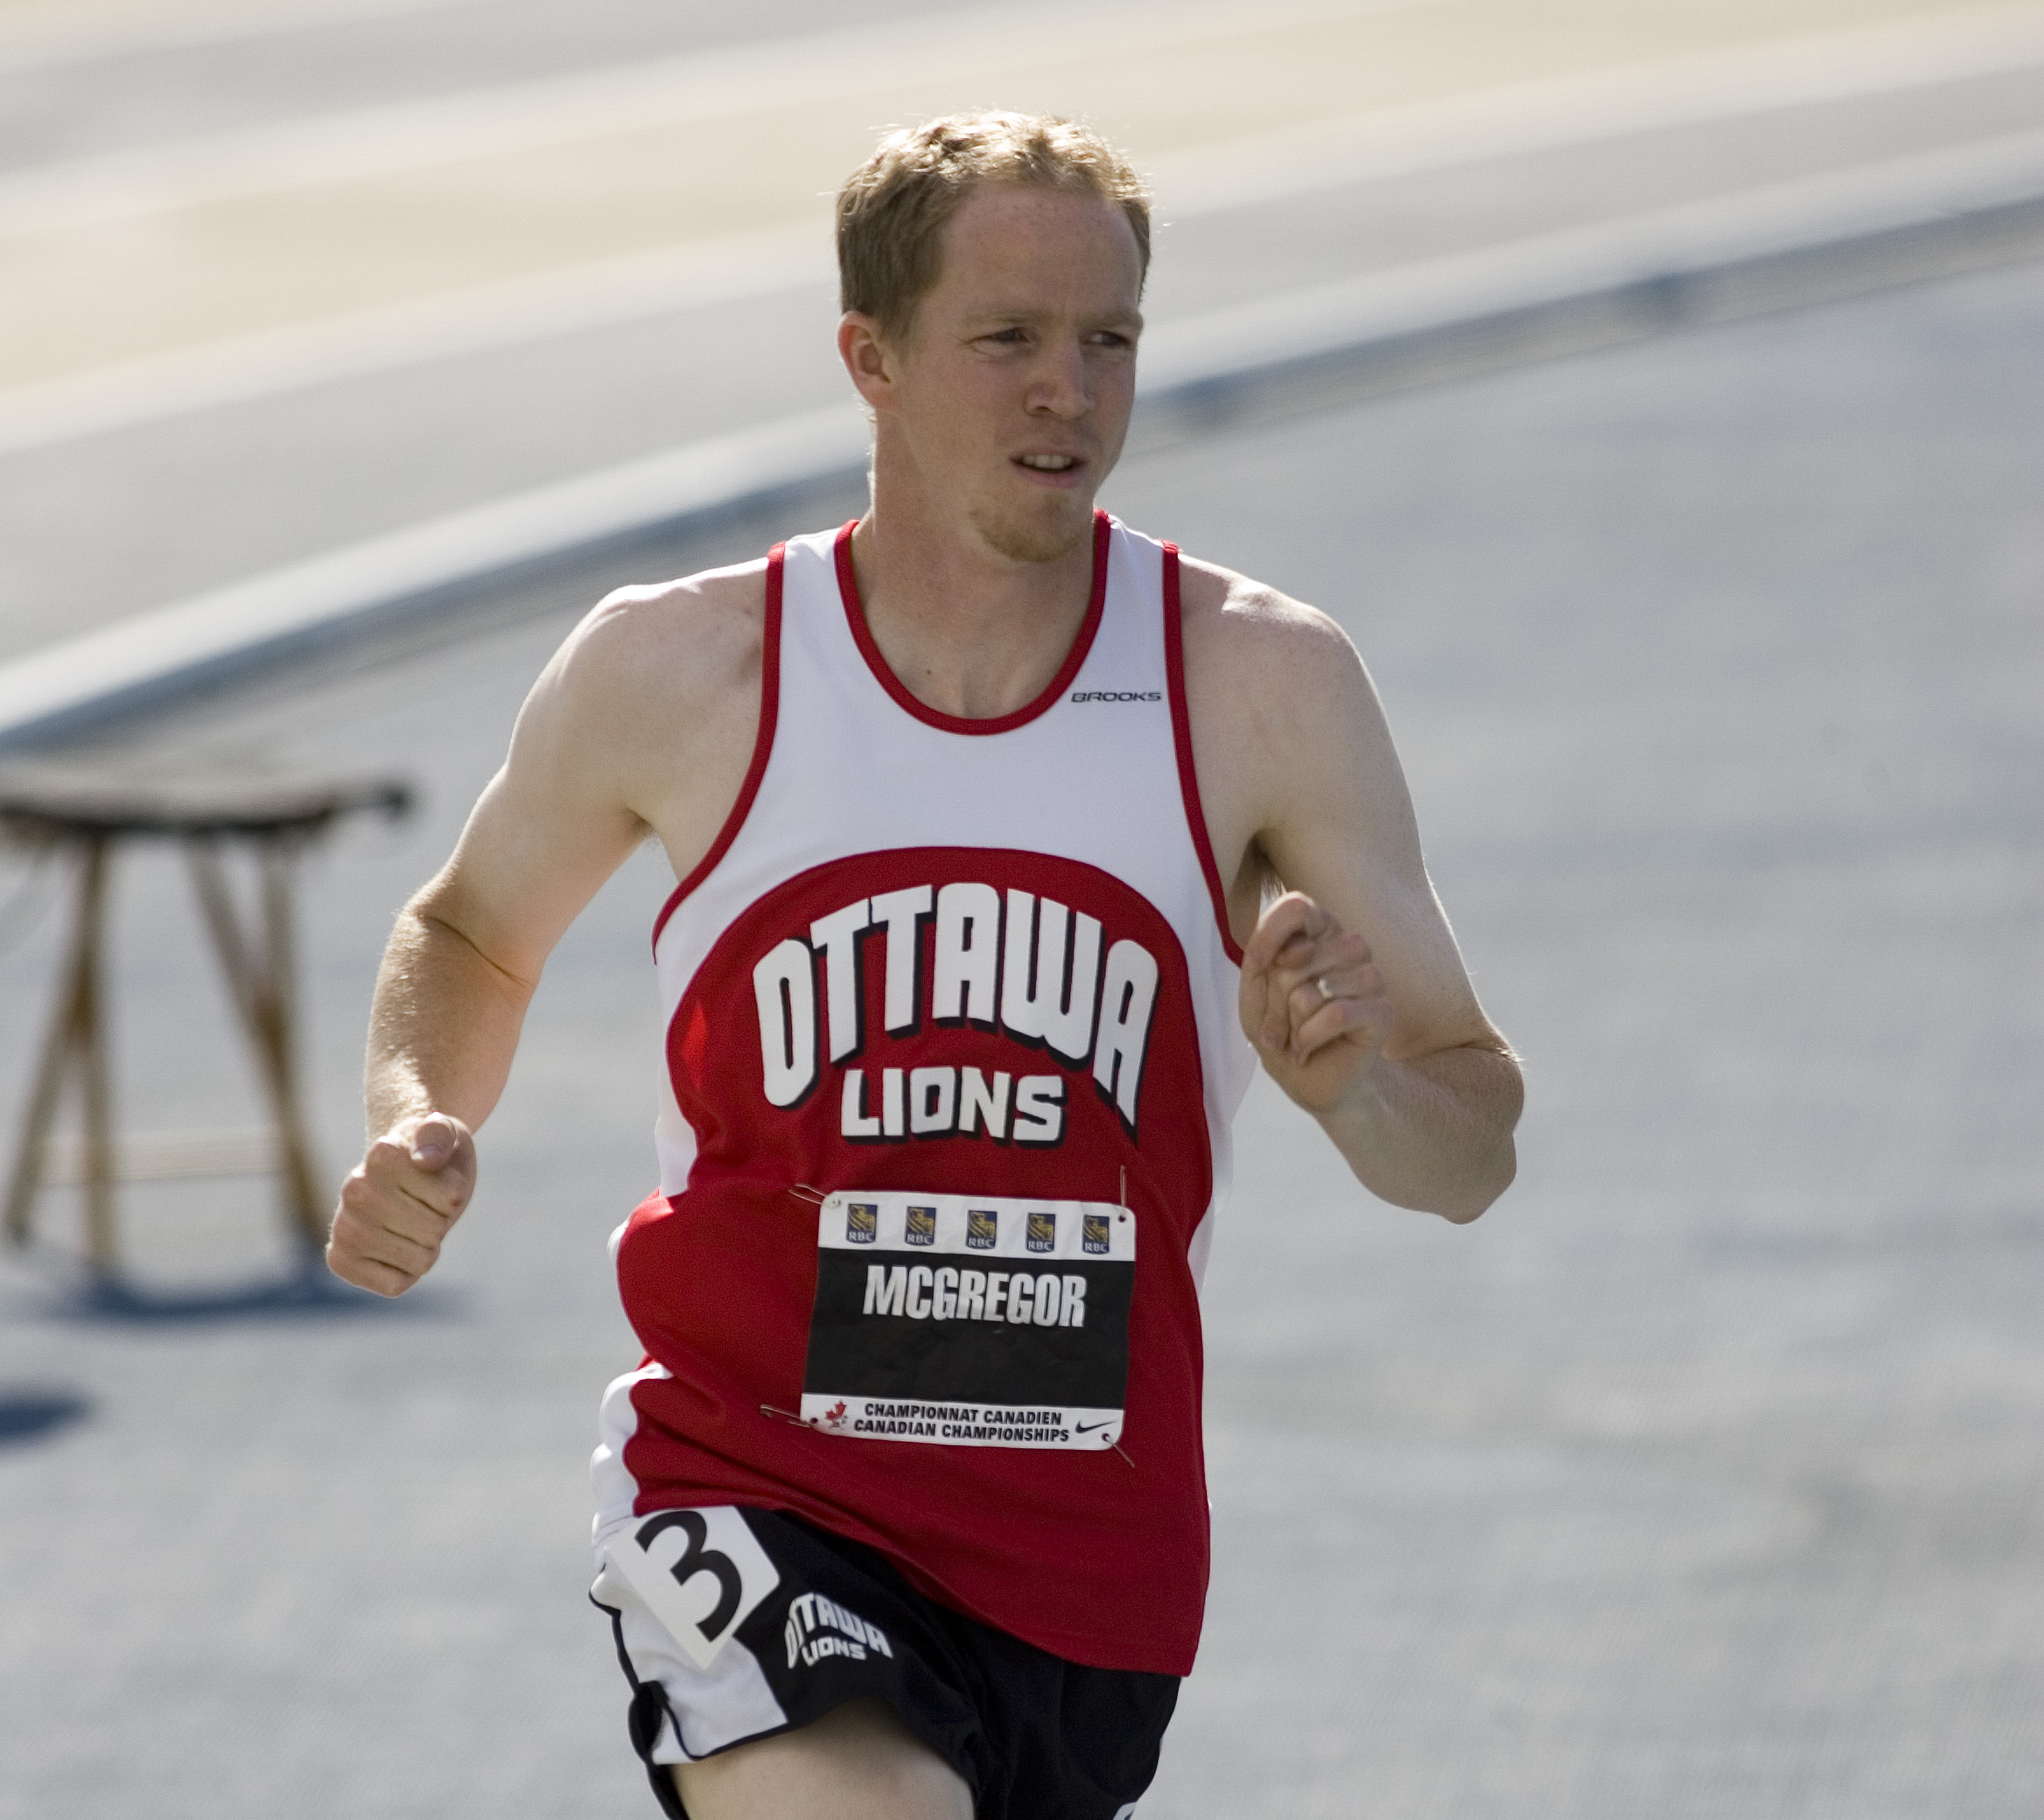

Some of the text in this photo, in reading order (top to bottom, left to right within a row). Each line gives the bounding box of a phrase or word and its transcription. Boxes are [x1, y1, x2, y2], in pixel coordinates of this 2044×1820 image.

[1071, 692, 1162, 703] BROOKS
[752, 882, 1160, 1130] OTTAWA
[840, 1066, 1064, 1143] LIONS
[848, 1230, 1109, 1253] RBC RBC RBC RBC RBC
[863, 1264, 1087, 1327] MCGREGOR
[853, 1419, 1069, 1443] CANADIAN CHAMPIONSHIPS
[864, 1403, 1062, 1426] CHAMPIONNAT CANADIEN
[634, 1510, 743, 1644] 3
[784, 1592, 894, 1670] OTTAWA
[802, 1636, 867, 1667] LIONS
